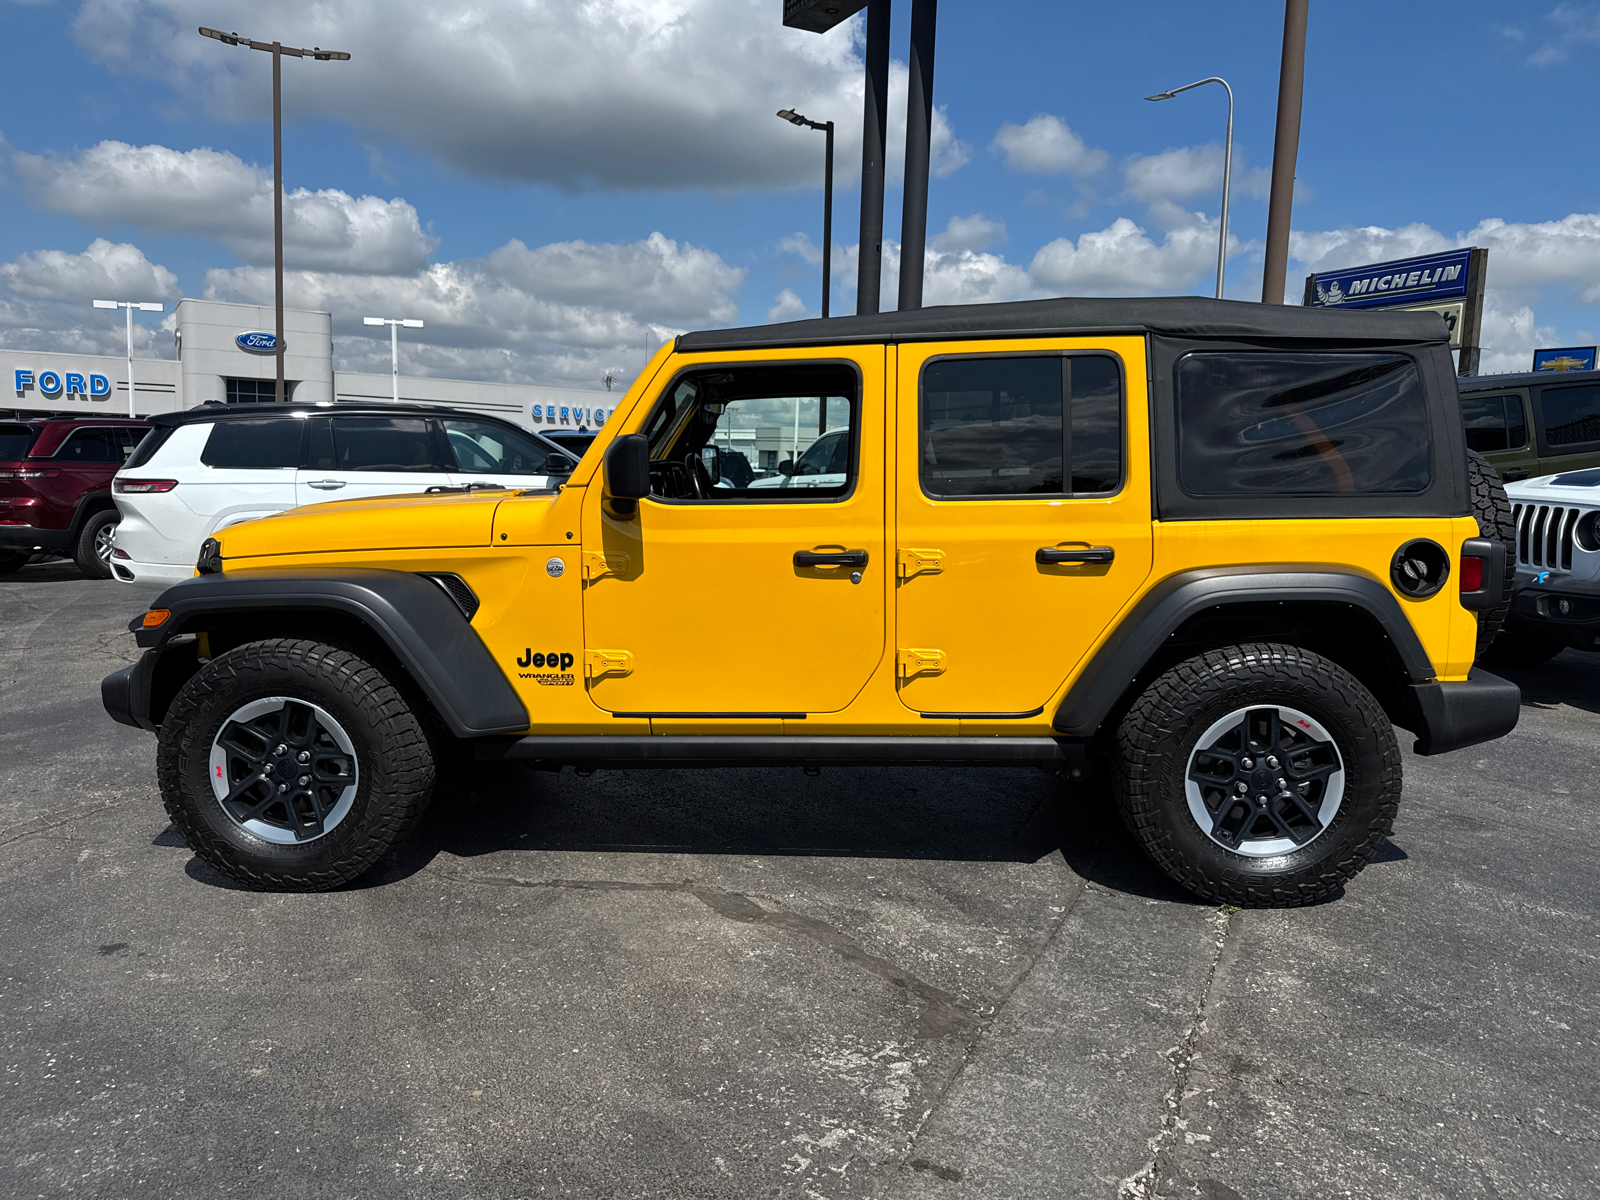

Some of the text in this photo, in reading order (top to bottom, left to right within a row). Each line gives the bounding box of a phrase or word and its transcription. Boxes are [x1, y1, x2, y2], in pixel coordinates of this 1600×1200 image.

[1349, 265, 1462, 295] MICHELIN
[246, 334, 276, 347] Ford
[14, 369, 110, 396] FORD
[516, 647, 574, 672] Jeep
